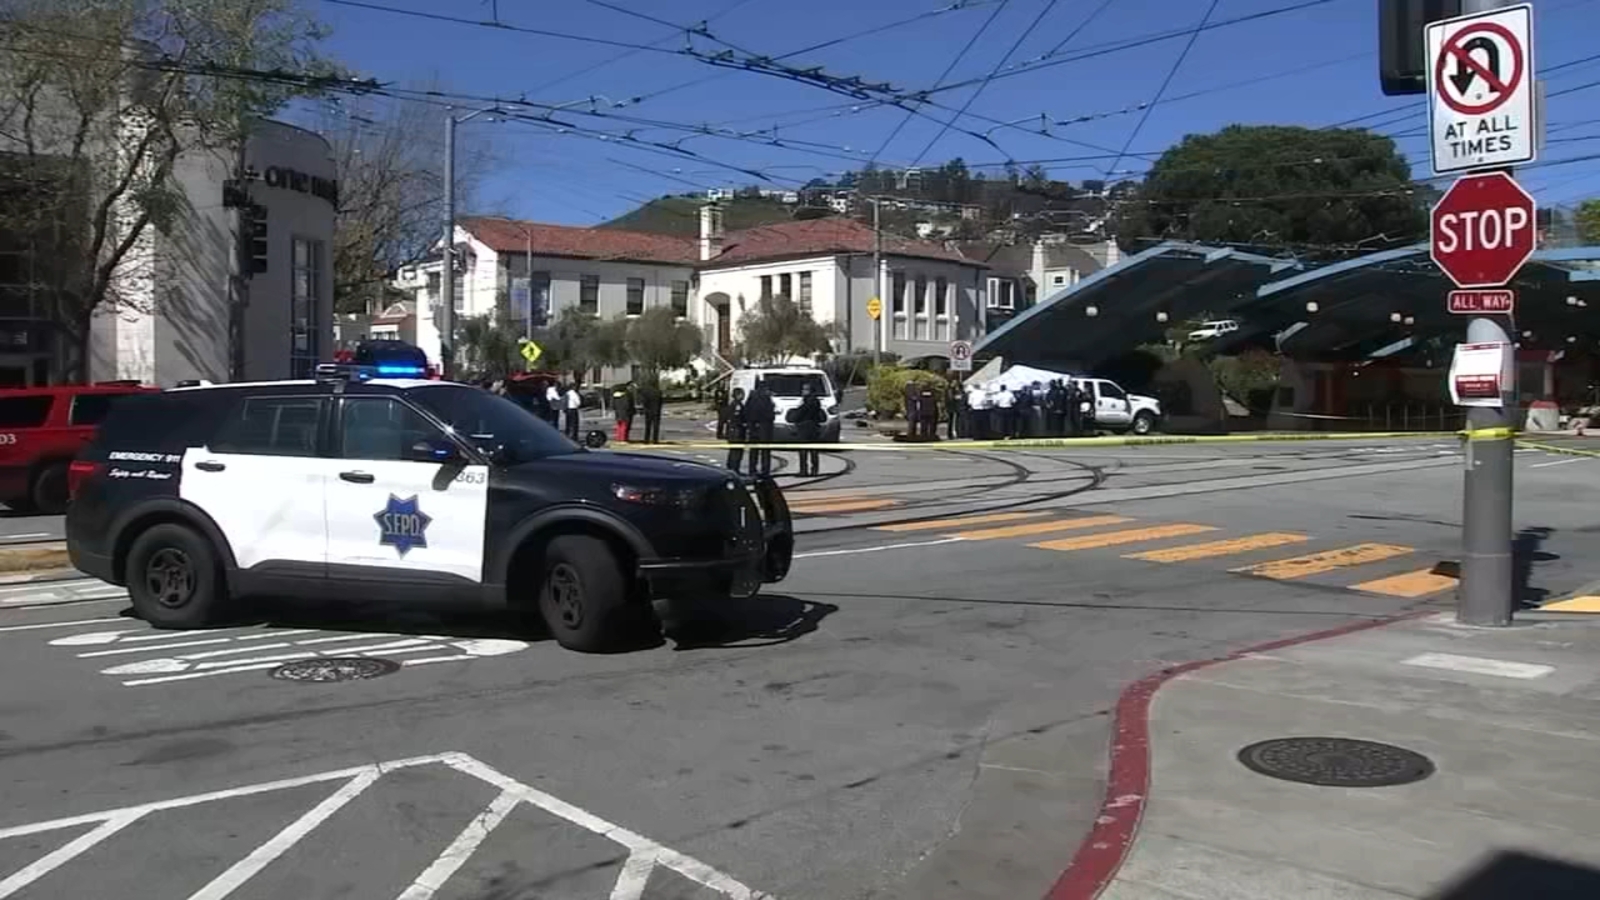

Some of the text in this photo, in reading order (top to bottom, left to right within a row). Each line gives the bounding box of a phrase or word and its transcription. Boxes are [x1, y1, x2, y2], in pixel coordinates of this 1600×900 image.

[1444, 115, 1518, 140] AT ALL
[1450, 135, 1512, 158] TIMES
[1438, 207, 1528, 253] STOP
[1453, 294, 1508, 309] ALL WAY
